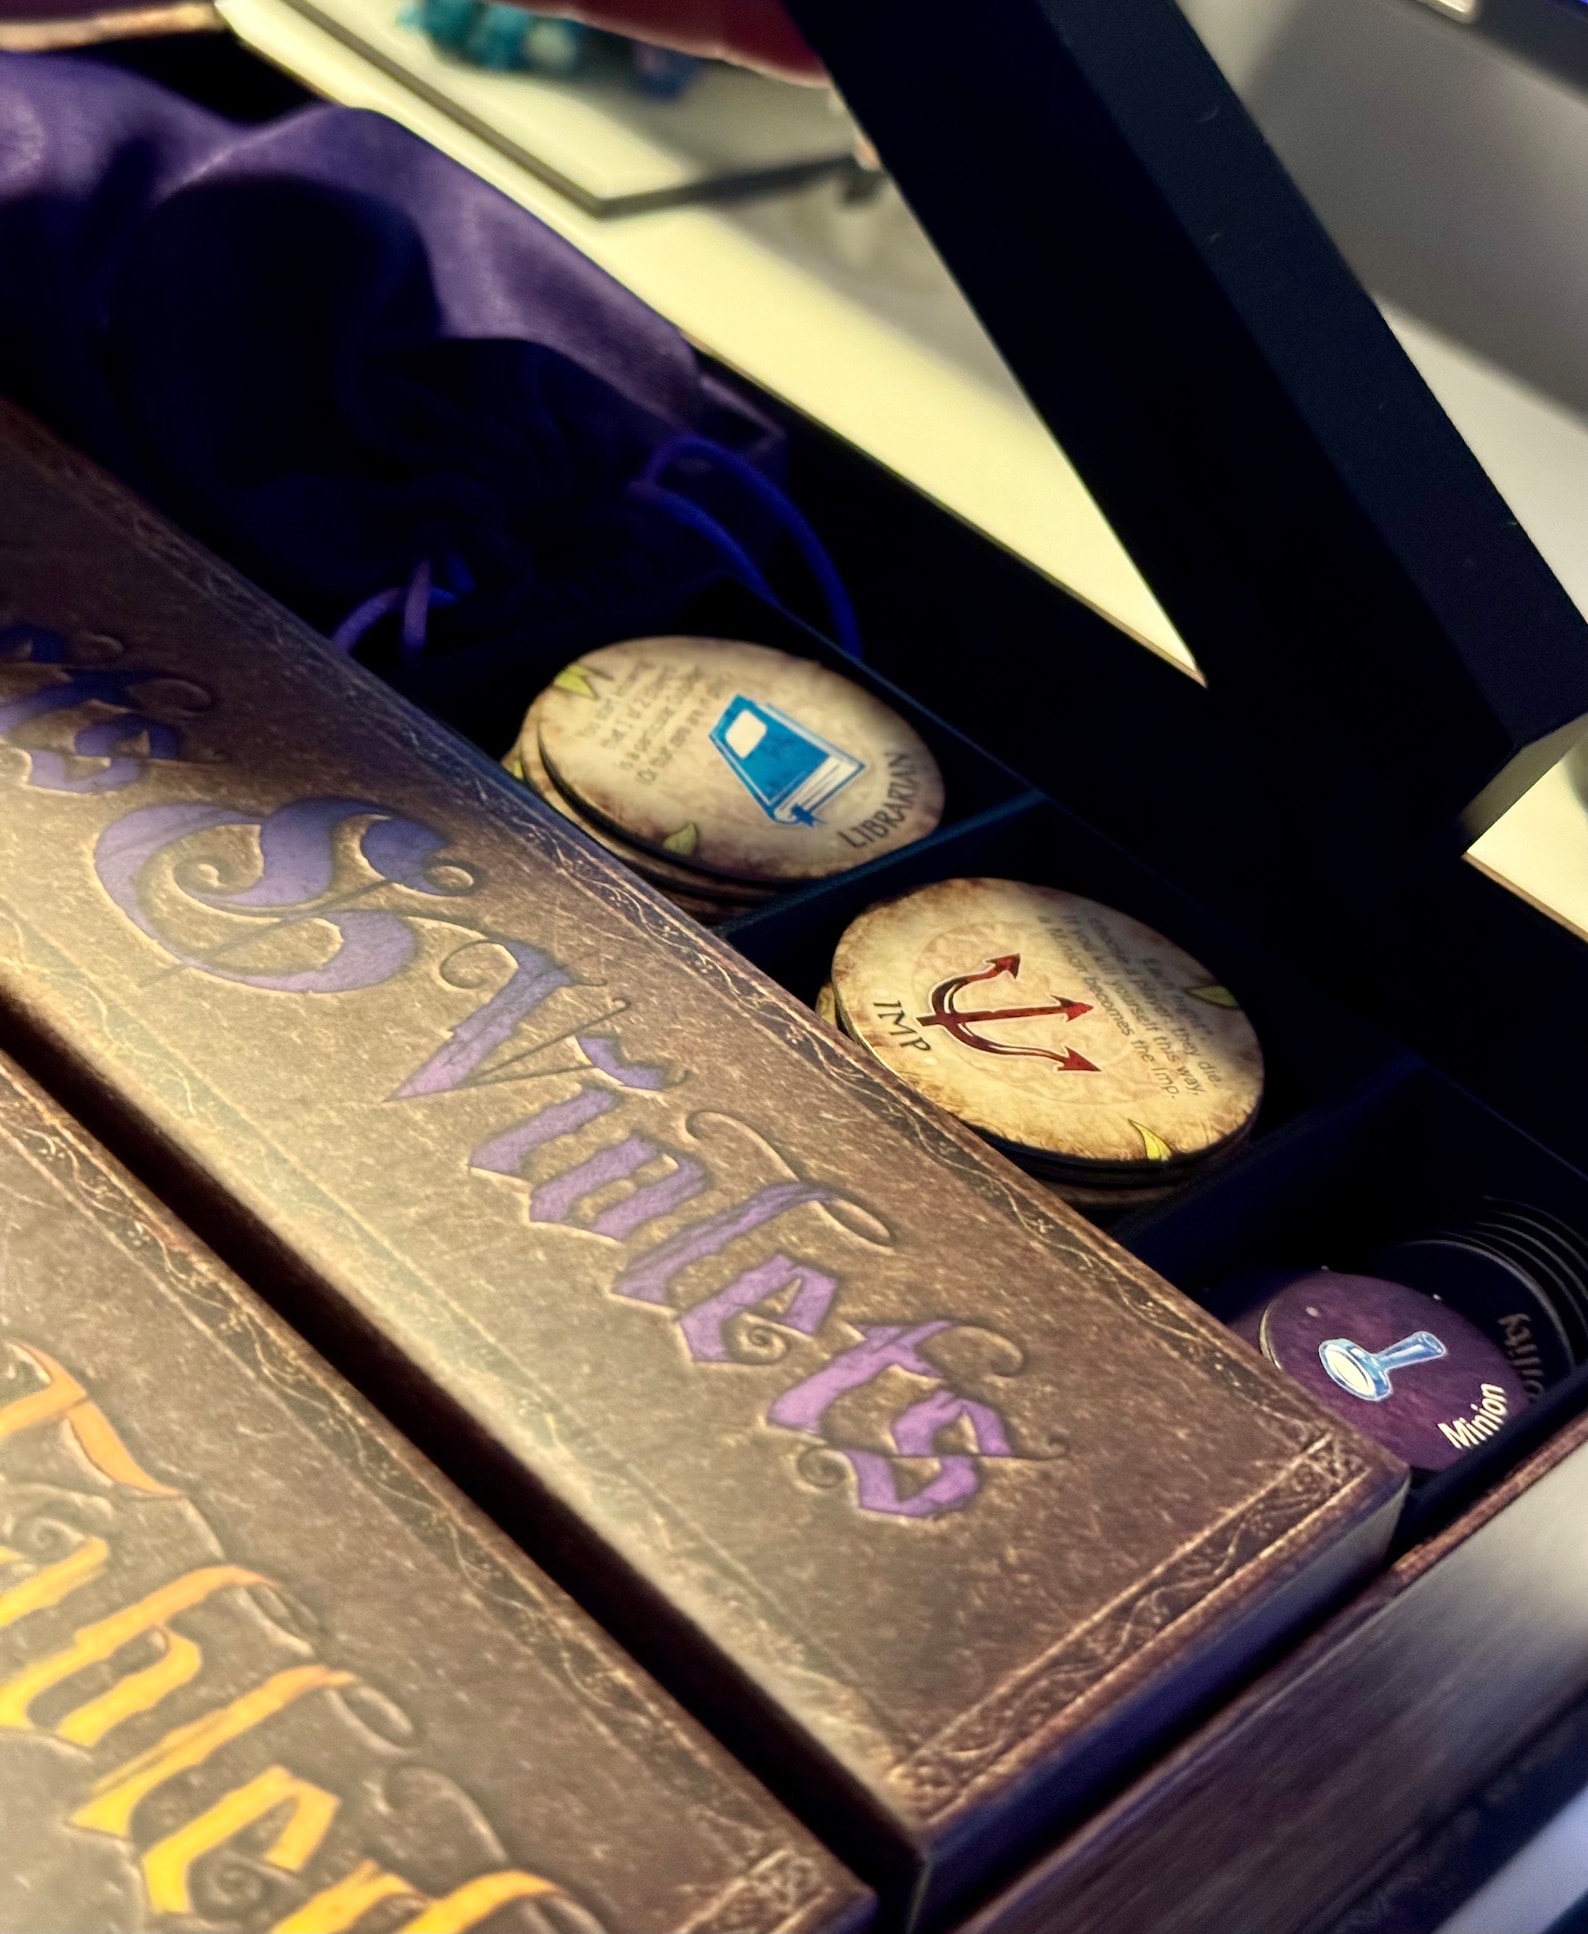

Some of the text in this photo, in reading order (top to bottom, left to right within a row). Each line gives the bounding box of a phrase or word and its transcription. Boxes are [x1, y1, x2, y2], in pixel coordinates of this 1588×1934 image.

[837, 751, 919, 850] LIBRARIAN
[872, 999, 932, 1055] IMP
[1082, 976, 1135, 1037] becomes
[1129, 1039, 1156, 1064] the
[1150, 1065, 1180, 1100] Imp.
[382, 912, 1068, 1520] Violets
[1437, 1381, 1510, 1450] Minion
